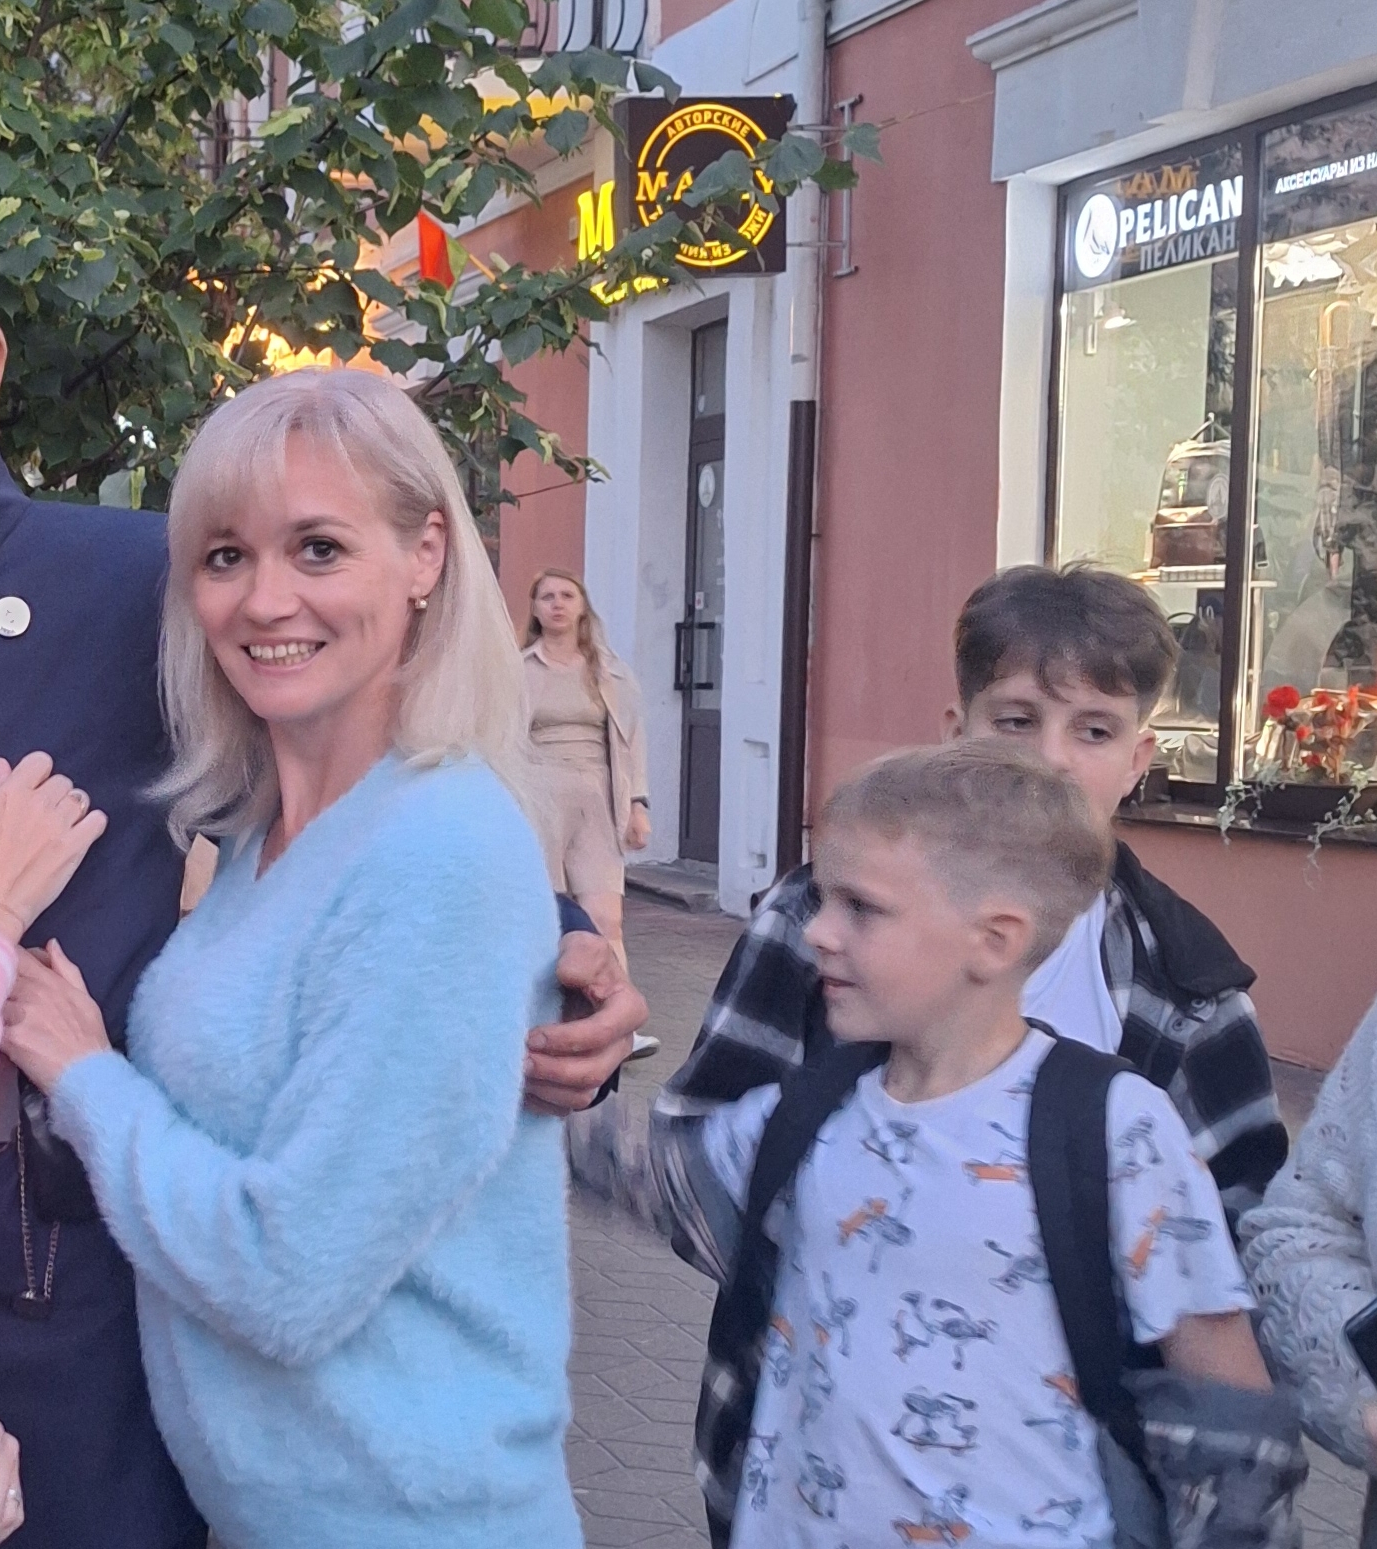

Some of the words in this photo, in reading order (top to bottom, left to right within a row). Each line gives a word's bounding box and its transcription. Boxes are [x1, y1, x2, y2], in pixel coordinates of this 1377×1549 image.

[666, 110, 751, 139] АВТОРСКИЕ
[1274, 159, 1348, 194] АКСЕССУАРЫ
[1349, 155, 1366, 175] ИЗ
[1118, 174, 1244, 249] PELICAN
[1139, 220, 1237, 272] ПЕЛИКАН
